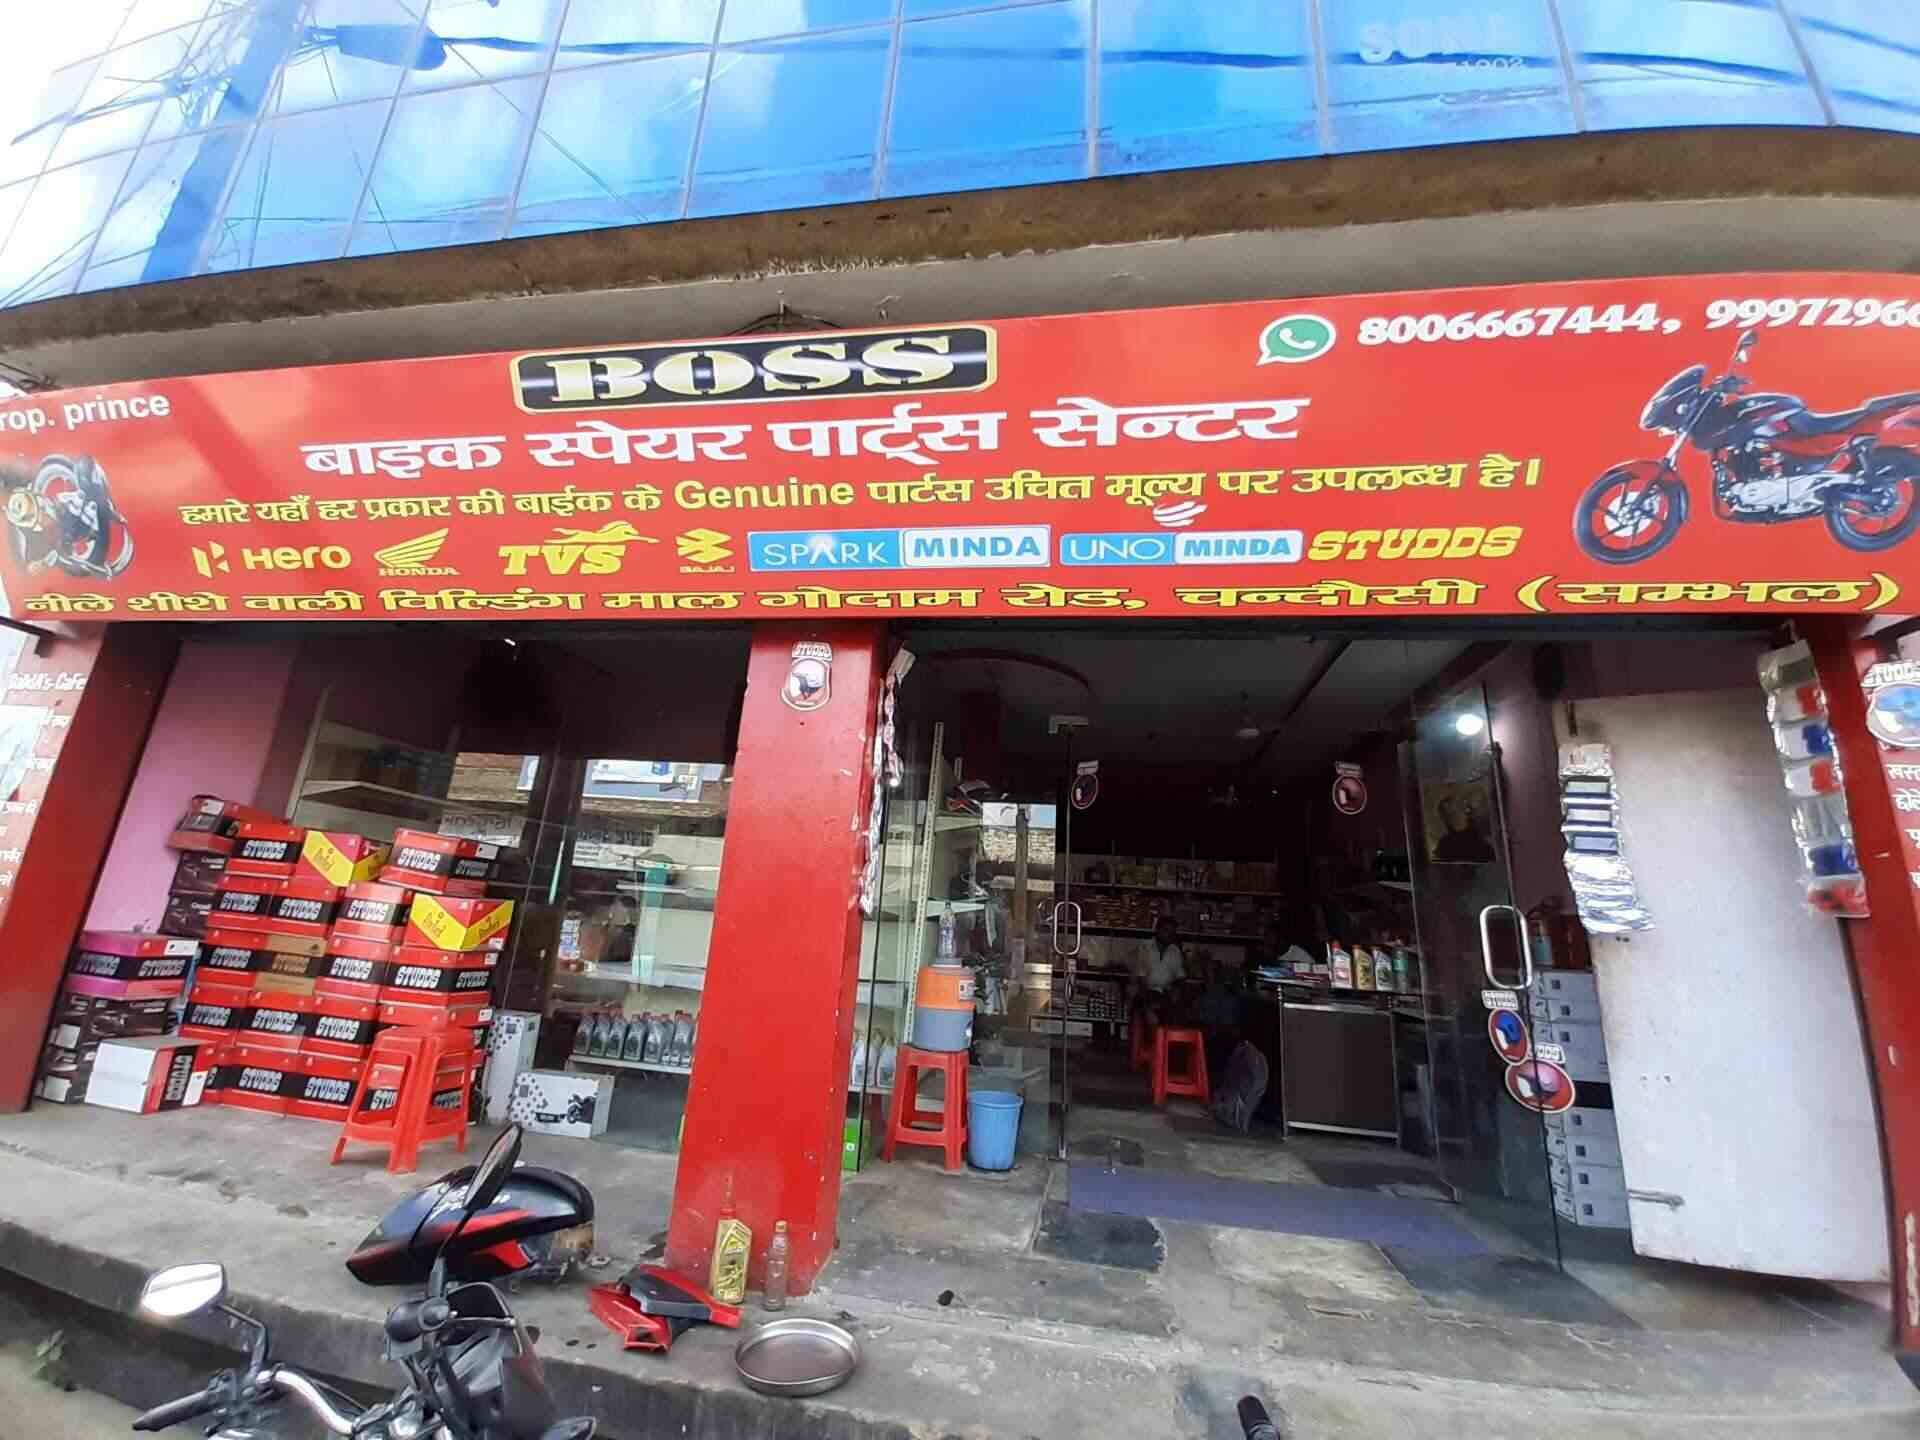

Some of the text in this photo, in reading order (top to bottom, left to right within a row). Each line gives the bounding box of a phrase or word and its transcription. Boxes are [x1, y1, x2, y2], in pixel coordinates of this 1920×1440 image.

[1358, 302, 1681, 345] 8006667444,
[546, 335, 954, 402] BOSS
[63, 394, 170, 431] prince
[300, 397, 1312, 479] बाइक स्पेयर पार्ट्स सेन्टर
[178, 498, 250, 525] हमारे
[254, 494, 310, 521] यहाँ
[316, 499, 359, 520] हर
[362, 496, 451, 521] प्रकार
[457, 488, 505, 516] की
[511, 484, 615, 517] बाईक
[622, 483, 664, 511] के
[674, 477, 855, 510] Genuine
[984, 468, 1096, 501] उचित
[1103, 472, 1207, 507] मूल्य
[1217, 469, 1285, 498] पर
[1290, 463, 1467, 493] उपलब्ध
[499, 544, 626, 576] TVS
[762, 535, 1042, 567] SPARK MINDA
[1069, 536, 1292, 560] UNO MINDA
[1306, 527, 1523, 561] STUDDS
[378, 567, 461, 577] HONDA
[24, 593, 115, 613] नीले
[601, 591, 746, 610] माल
[755, 585, 984, 609] गोदाम
[394, 966, 441, 988] STUDDS
